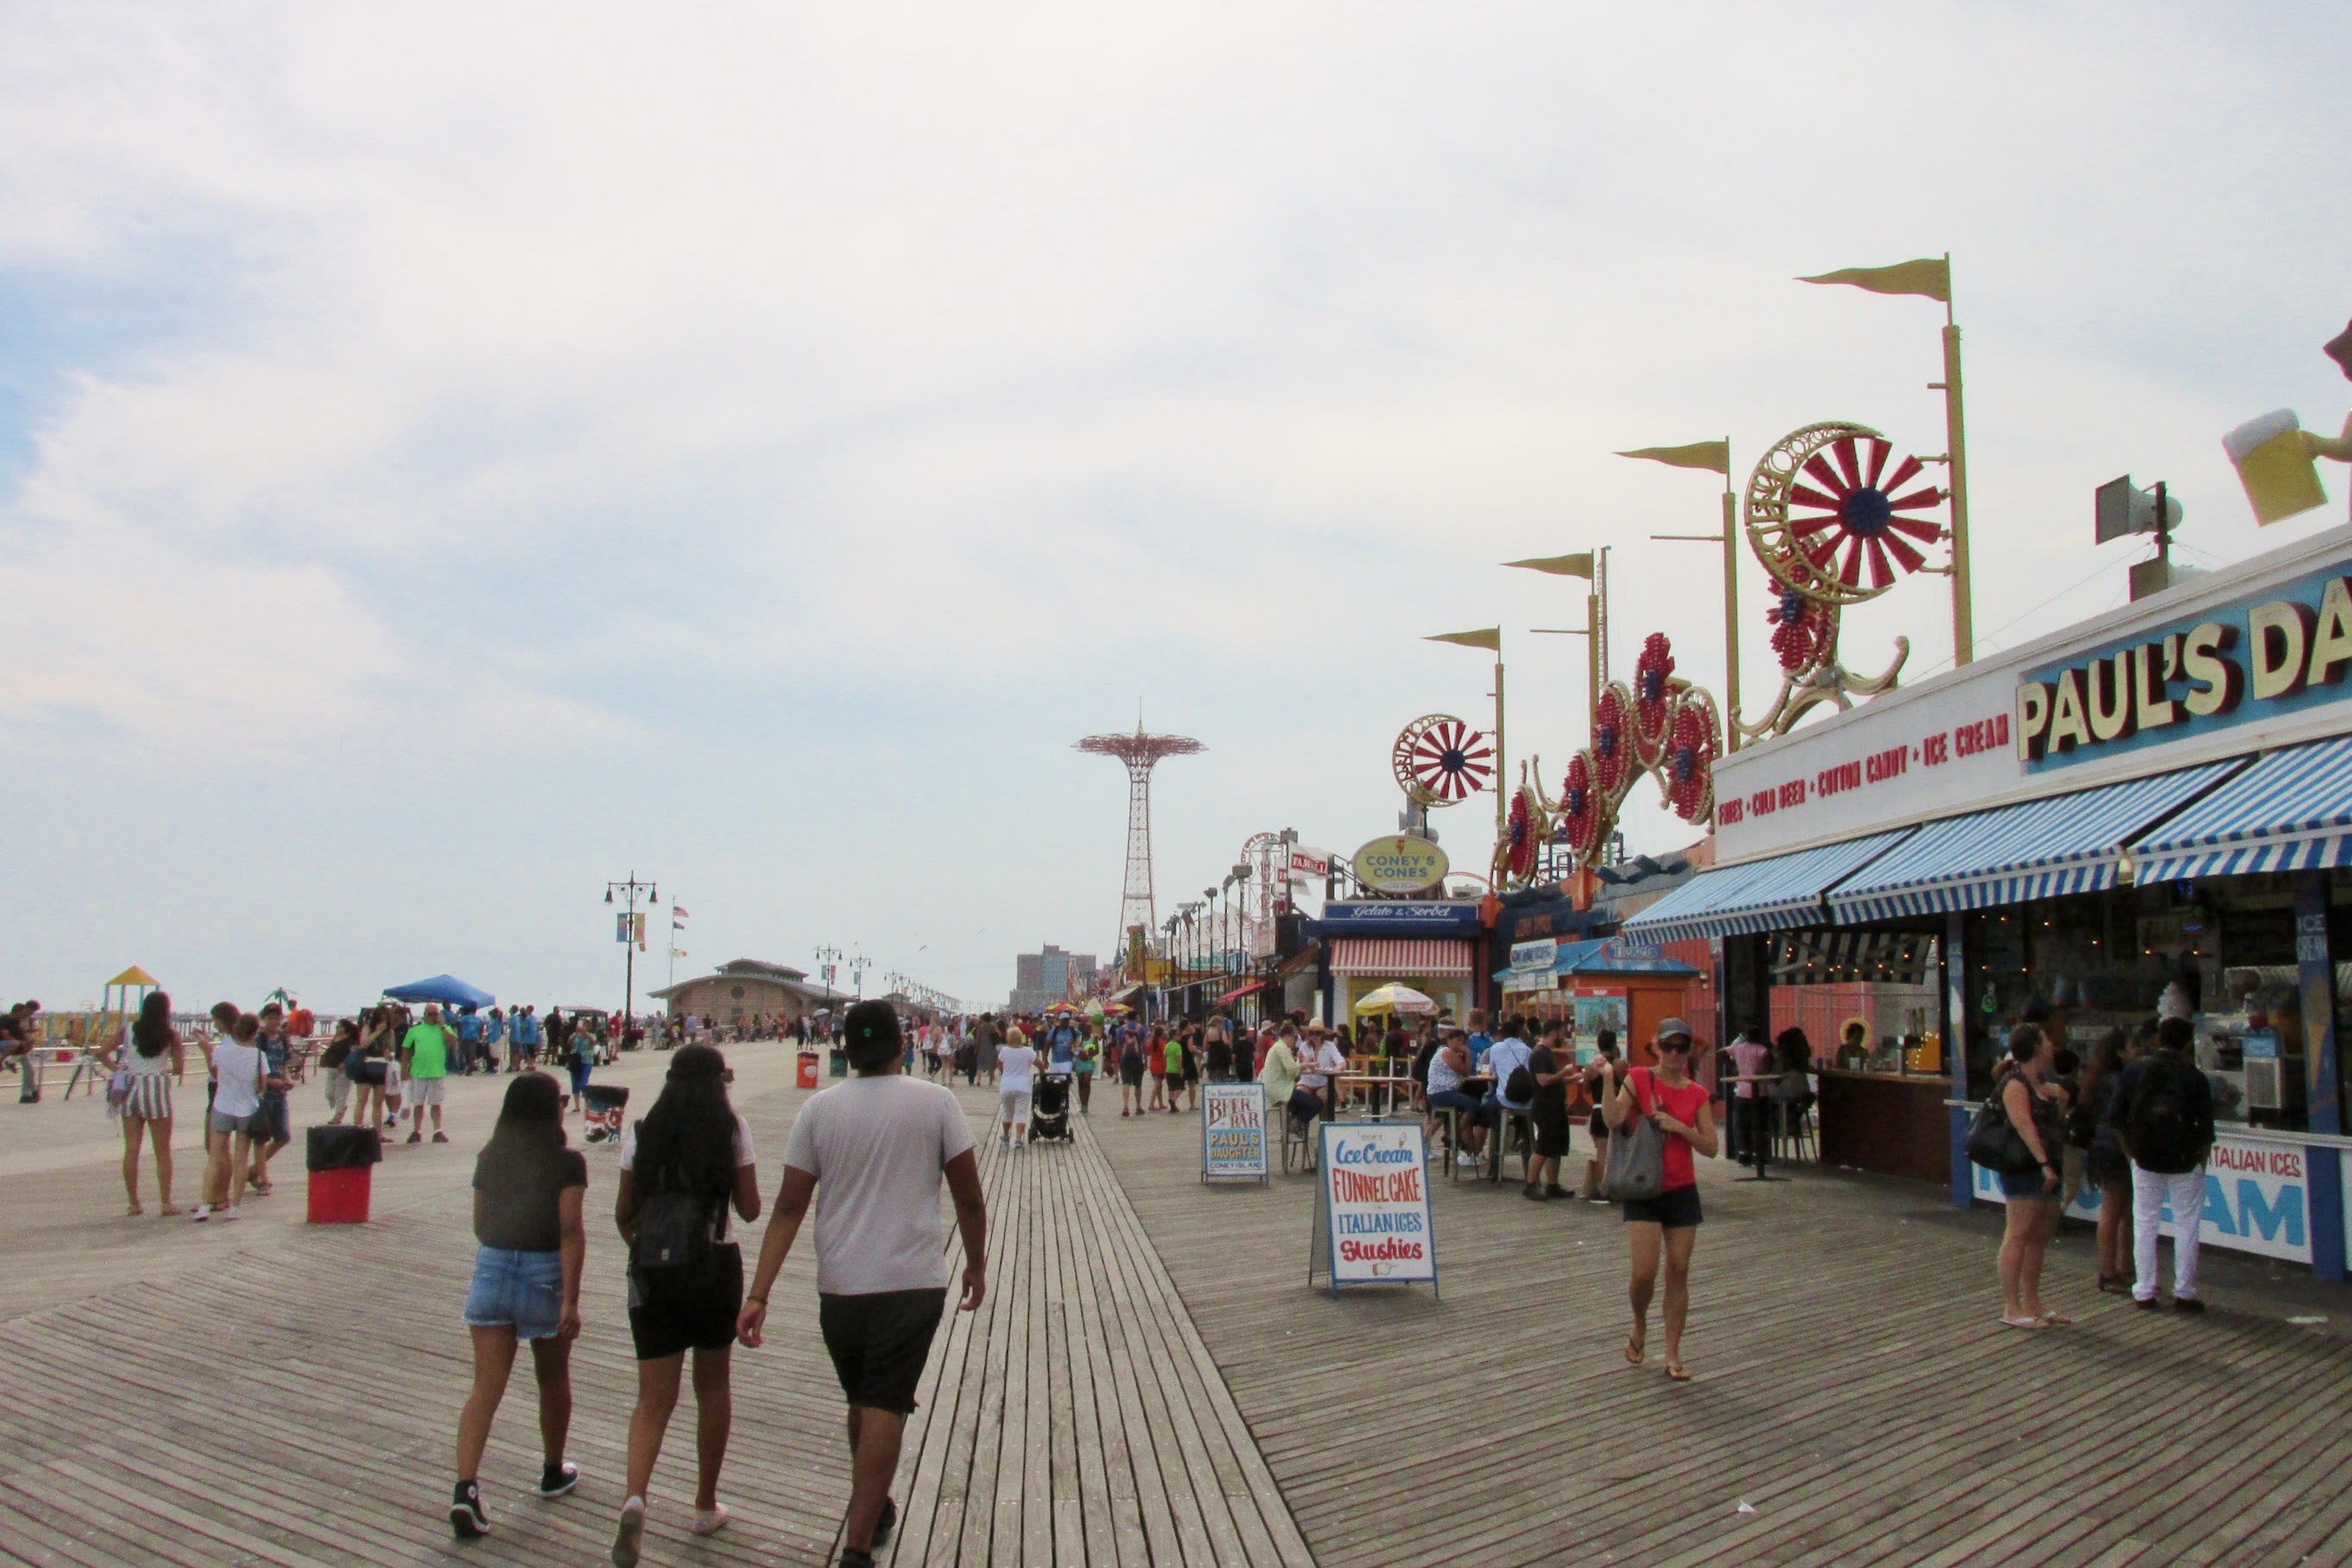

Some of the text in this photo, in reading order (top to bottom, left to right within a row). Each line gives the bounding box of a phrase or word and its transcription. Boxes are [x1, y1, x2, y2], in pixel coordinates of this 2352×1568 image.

[2016, 575, 2352, 761] PAUL'S DA
[1718, 798, 1743, 825] FRIES
[1779, 779, 1805, 808] BEER
[1818, 760, 1861, 798] COTTON
[1866, 744, 1909, 784] CANDY
[1923, 732, 1948, 766] ICE
[1954, 713, 2010, 758] CREAM
[1365, 855, 1436, 866] CONEY'S
[1373, 867, 1428, 878] CONES
[1351, 905, 1393, 918] Gelato
[1405, 905, 1451, 917] Sorbet
[1207, 1098, 1251, 1127] BEER
[1230, 1111, 1260, 1128] BAR
[1210, 1147, 1260, 1160] DAUGHTER
[1335, 1139, 1414, 1164] Ice Cream
[2209, 1145, 2302, 1178] TALIAN ICES
[1333, 1166, 1421, 1204] FUNNEL CAKE
[1339, 1212, 1422, 1234] ITALIAN ICES
[1339, 1236, 1423, 1262] Slushies
